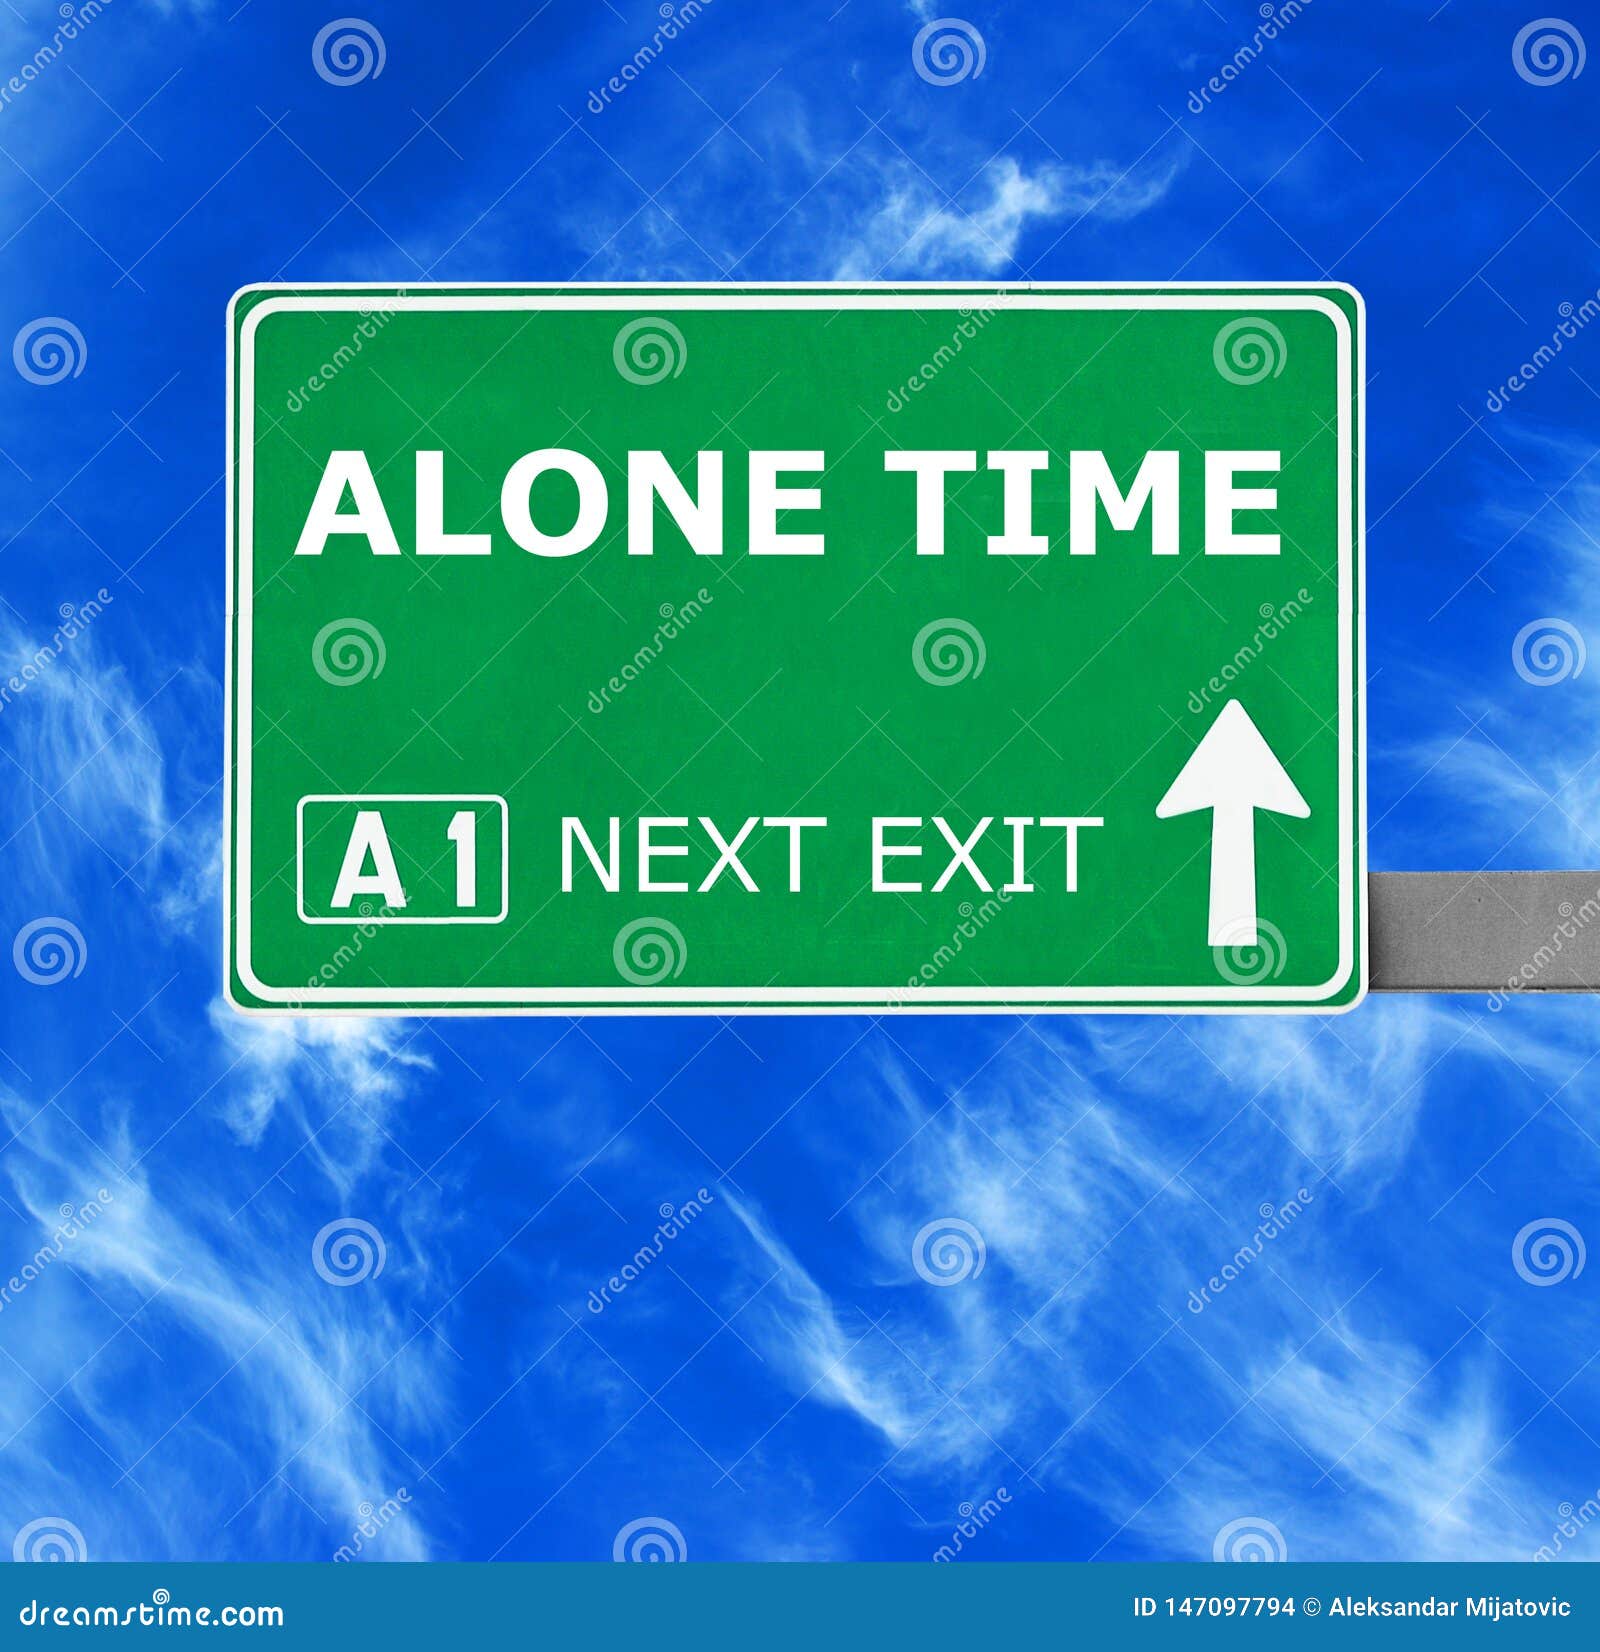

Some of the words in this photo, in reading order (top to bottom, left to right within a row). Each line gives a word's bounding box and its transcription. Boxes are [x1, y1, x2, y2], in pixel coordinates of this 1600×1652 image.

[294, 449, 825, 557] ALONE
[885, 451, 1281, 555] TIME
[562, 816, 828, 893] NEXT
[872, 816, 1104, 893] EXIT
